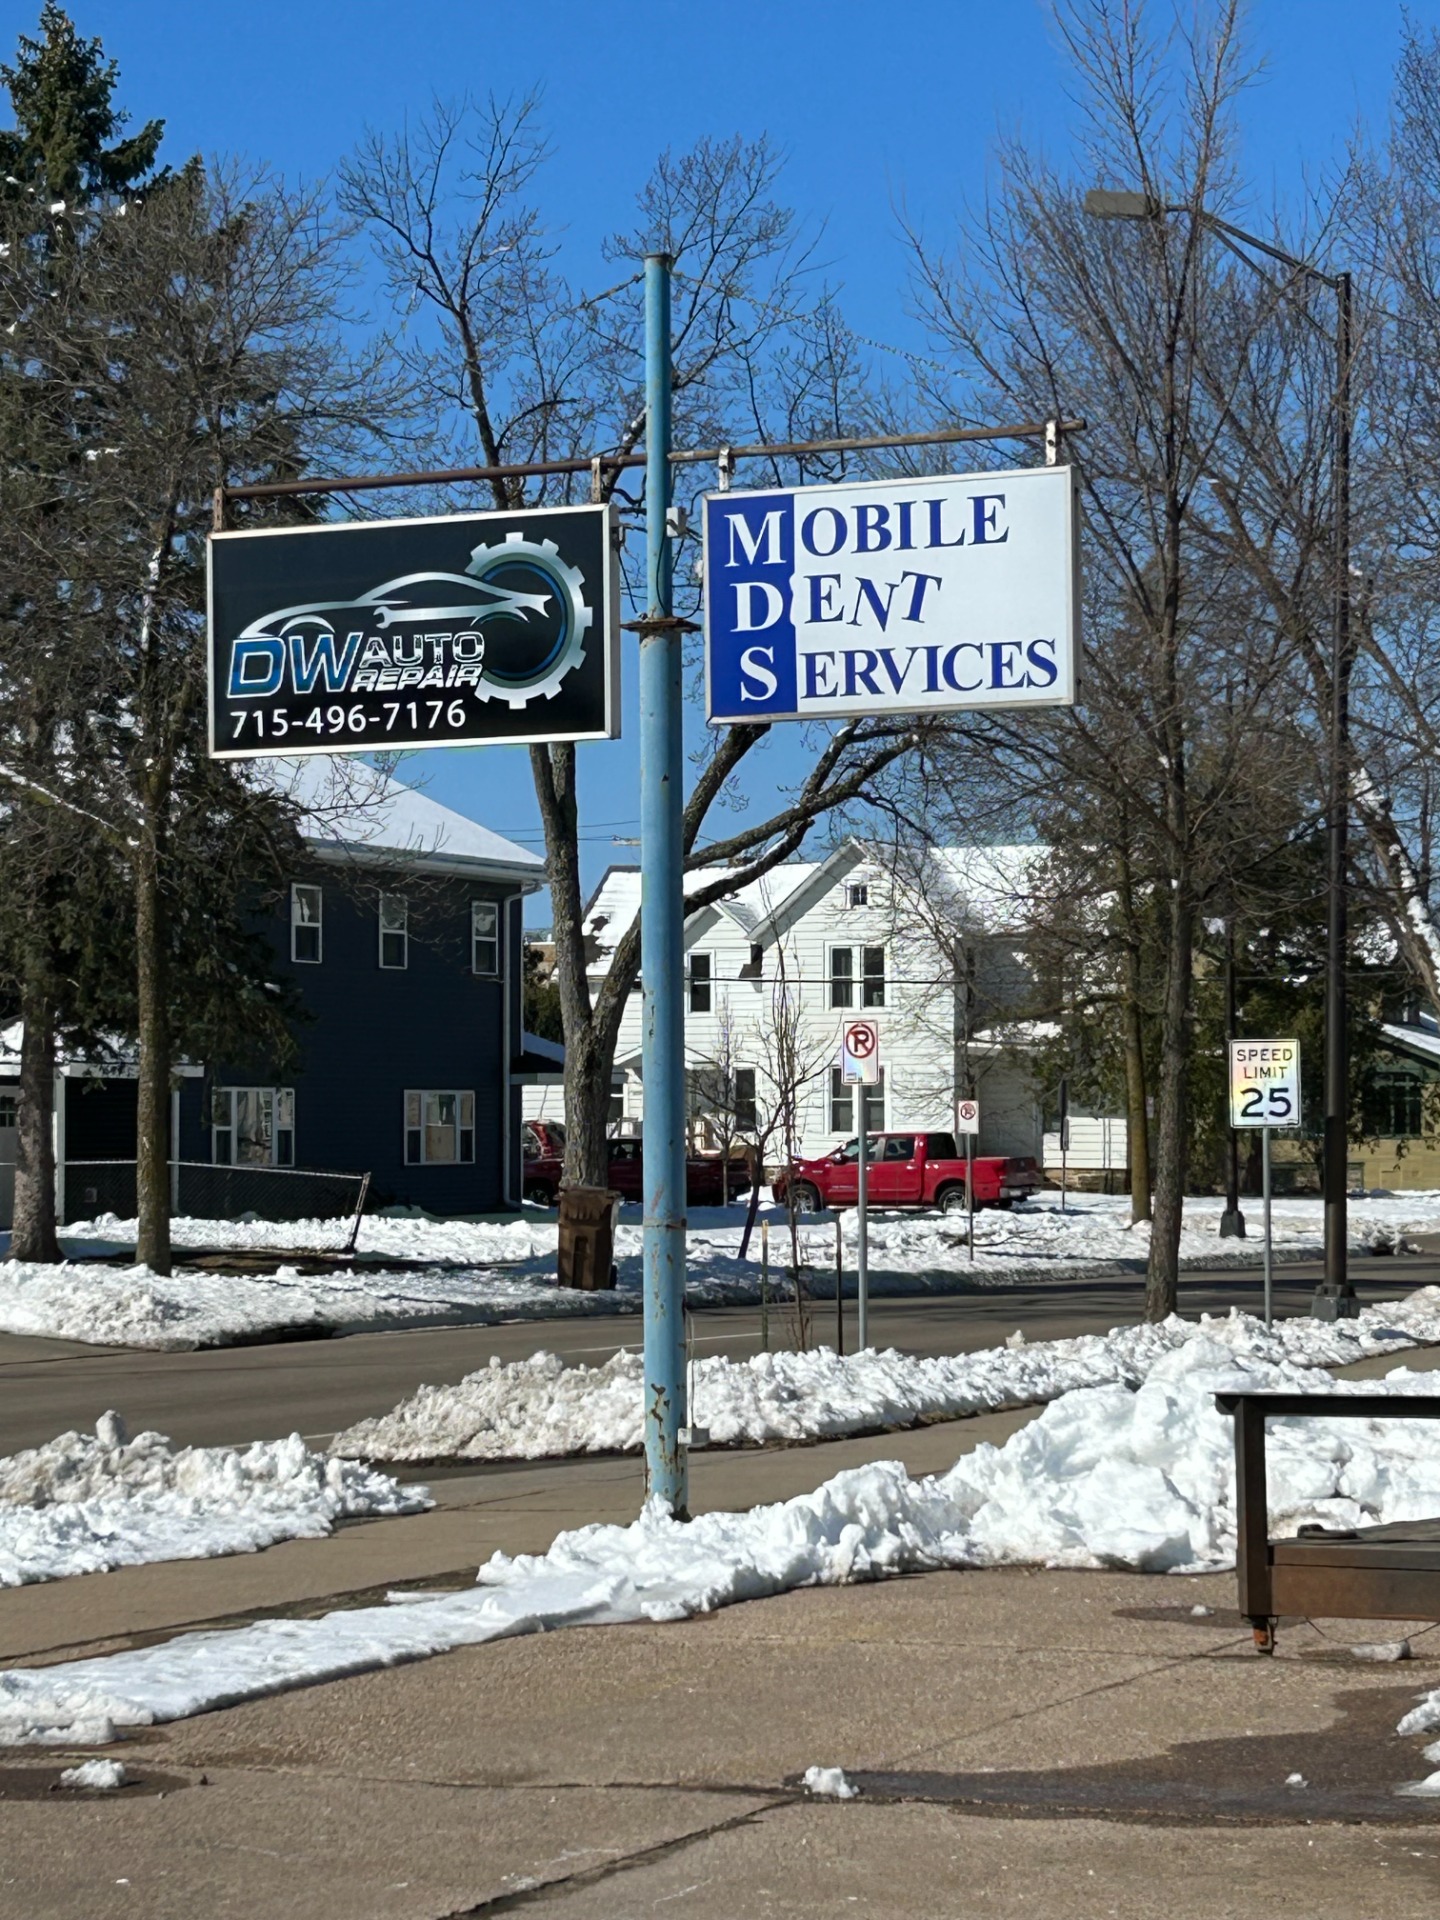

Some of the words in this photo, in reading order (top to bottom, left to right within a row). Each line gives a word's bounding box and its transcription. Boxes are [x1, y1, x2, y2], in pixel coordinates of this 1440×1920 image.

[724, 494, 1010, 567] MOBILE
[730, 571, 943, 632] DENT
[227, 632, 363, 698] DW
[358, 631, 485, 668] AUTO
[351, 663, 484, 693] REPAIR
[740, 639, 1059, 701] SERVICES
[230, 699, 466, 739] 715-496-7176
[1236, 1048, 1293, 1062] SPEED
[1243, 1066, 1288, 1079] LIMIT
[1240, 1087, 1292, 1118] 25
